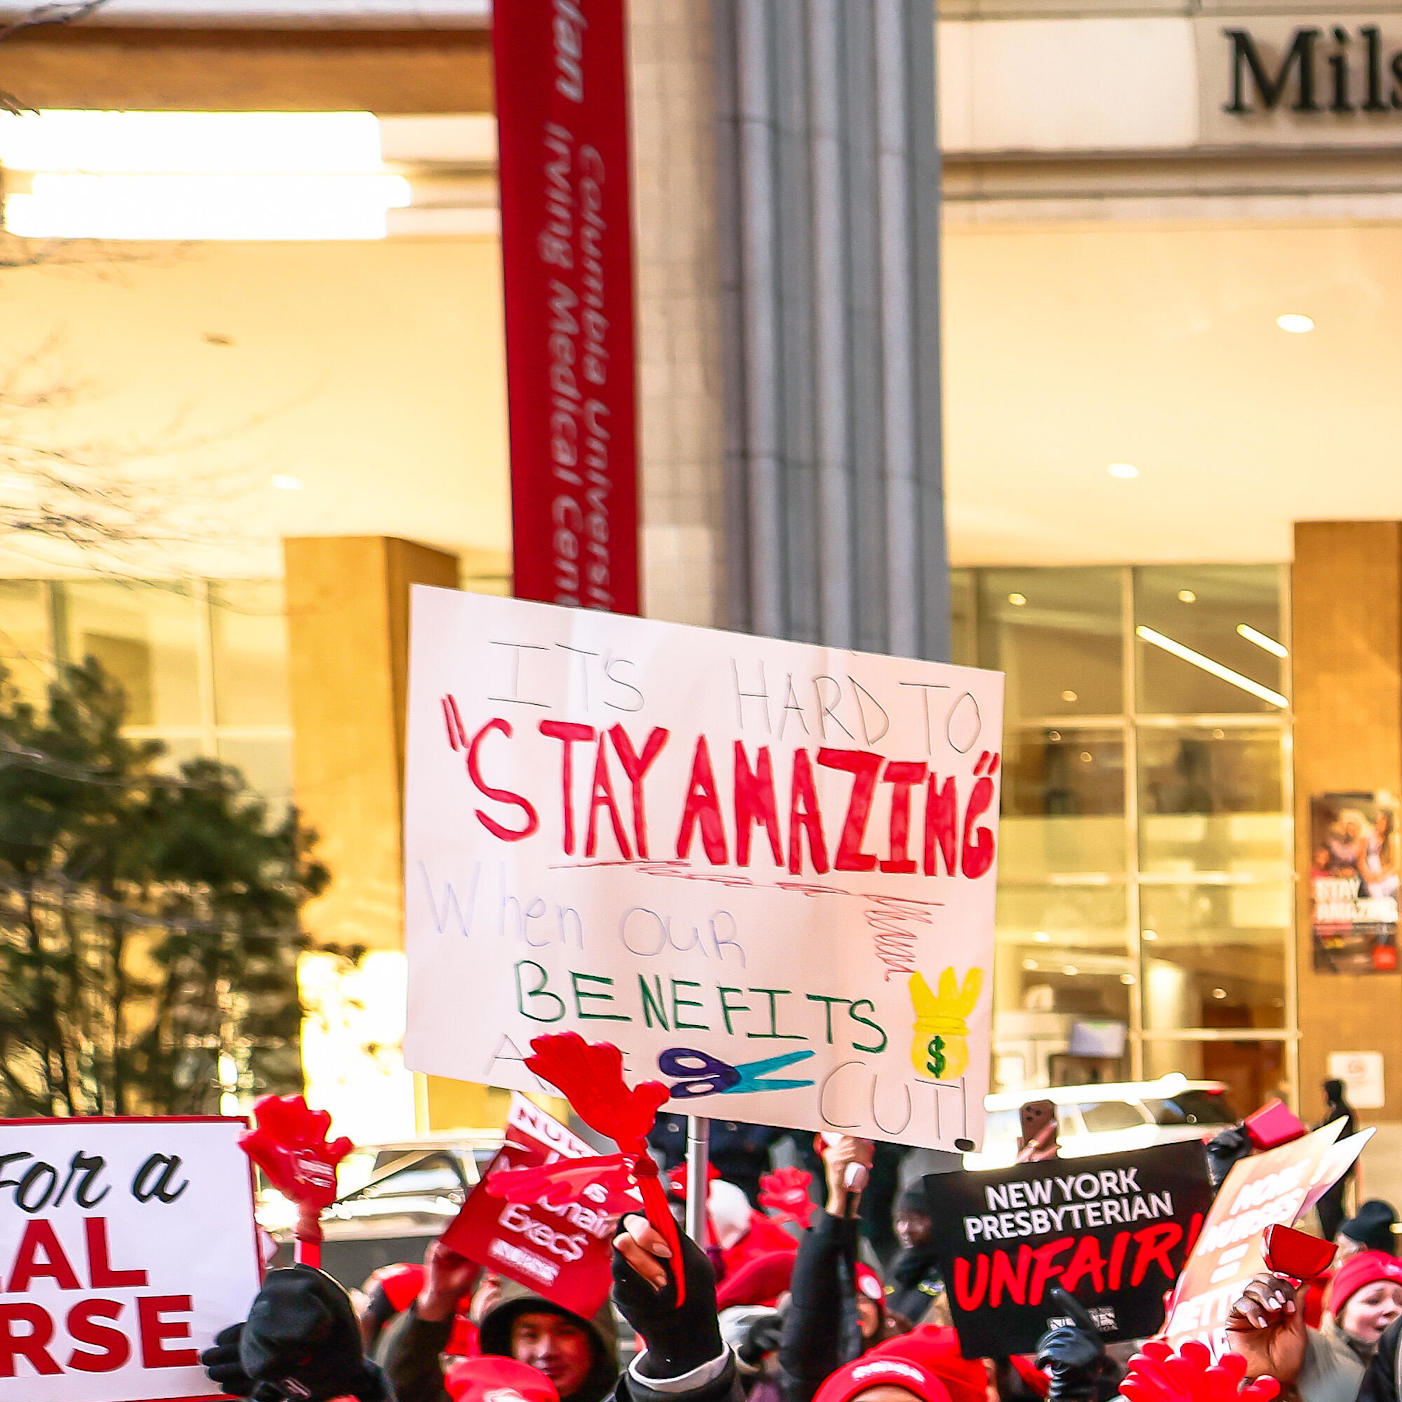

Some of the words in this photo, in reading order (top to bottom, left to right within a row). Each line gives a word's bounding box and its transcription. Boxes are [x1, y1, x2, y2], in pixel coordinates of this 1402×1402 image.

[549, 277, 583, 487] Medical
[731, 657, 890, 745] HARD
[899, 681, 983, 755] TO
[514, 959, 890, 1054] BENEFITS
[131, 1152, 190, 1204] a
[985, 1177, 1052, 1212] NEW
[1053, 1166, 1142, 1202] YORK
[0, 1216, 151, 1293] AL
[962, 1191, 1174, 1243] PRESBYTERIAN
